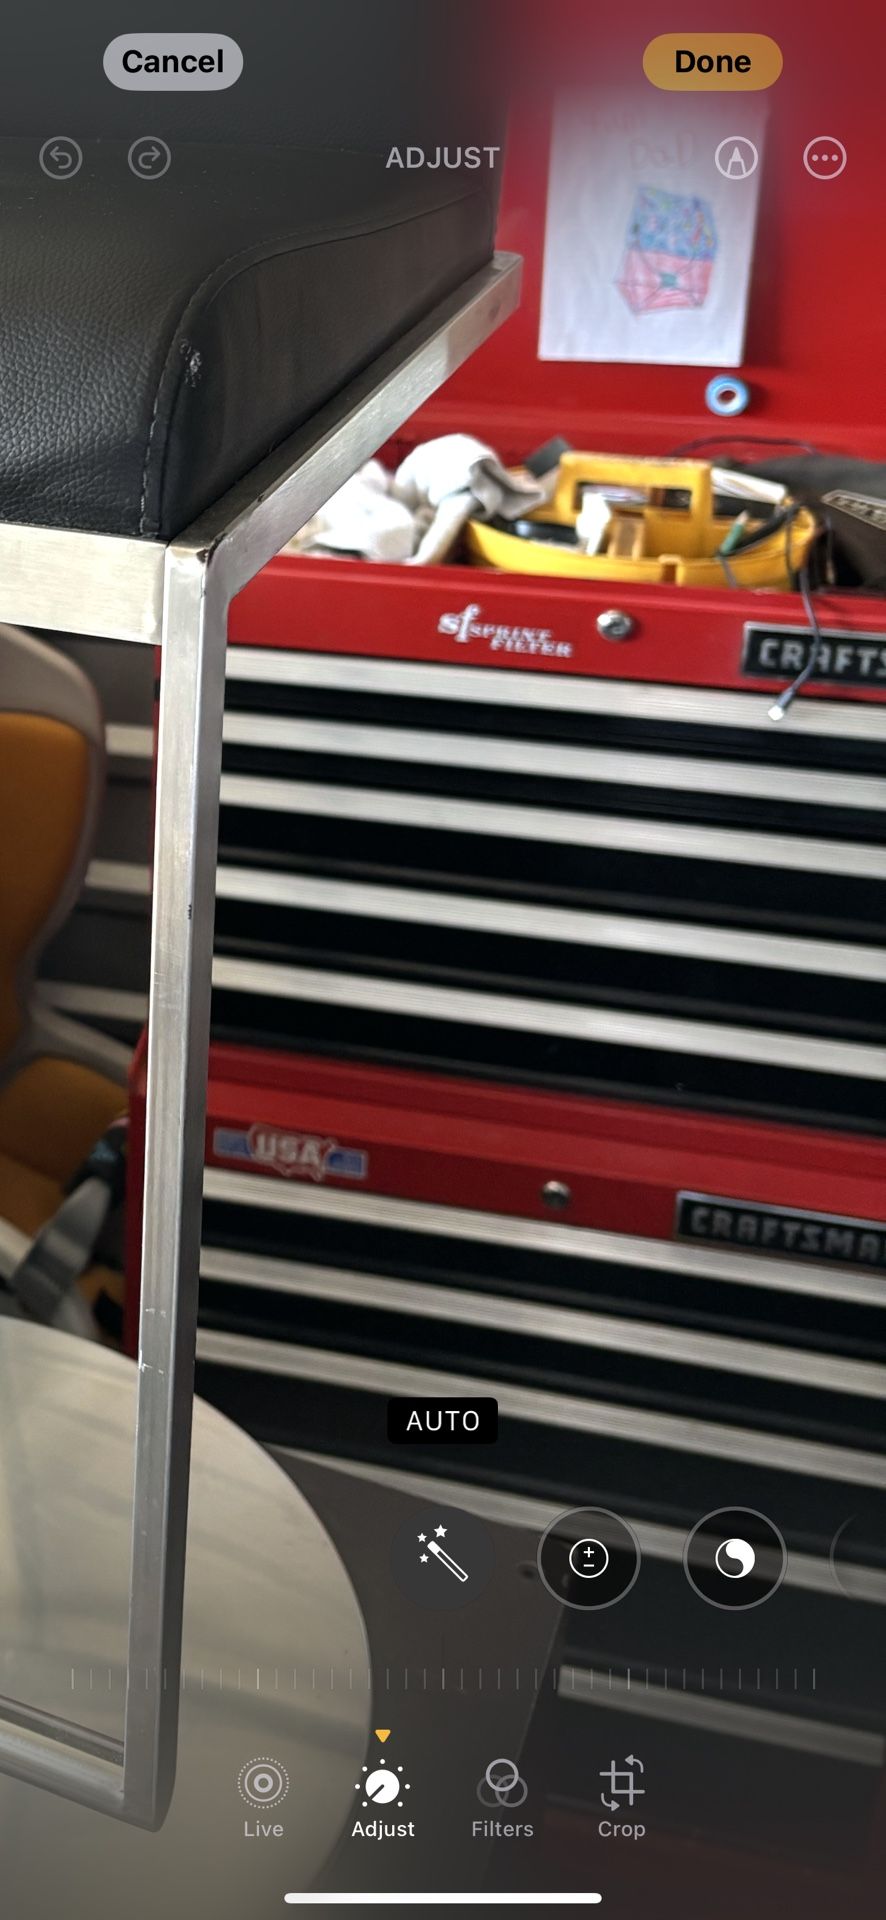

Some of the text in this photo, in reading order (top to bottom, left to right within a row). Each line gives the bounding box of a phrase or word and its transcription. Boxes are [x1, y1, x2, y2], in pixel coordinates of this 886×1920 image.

[469, 623, 552, 642] SPRINT
[489, 636, 574, 658] FILTER
[254, 1133, 321, 1166] USA
[690, 1206, 886, 1261] CRAFTSMA
